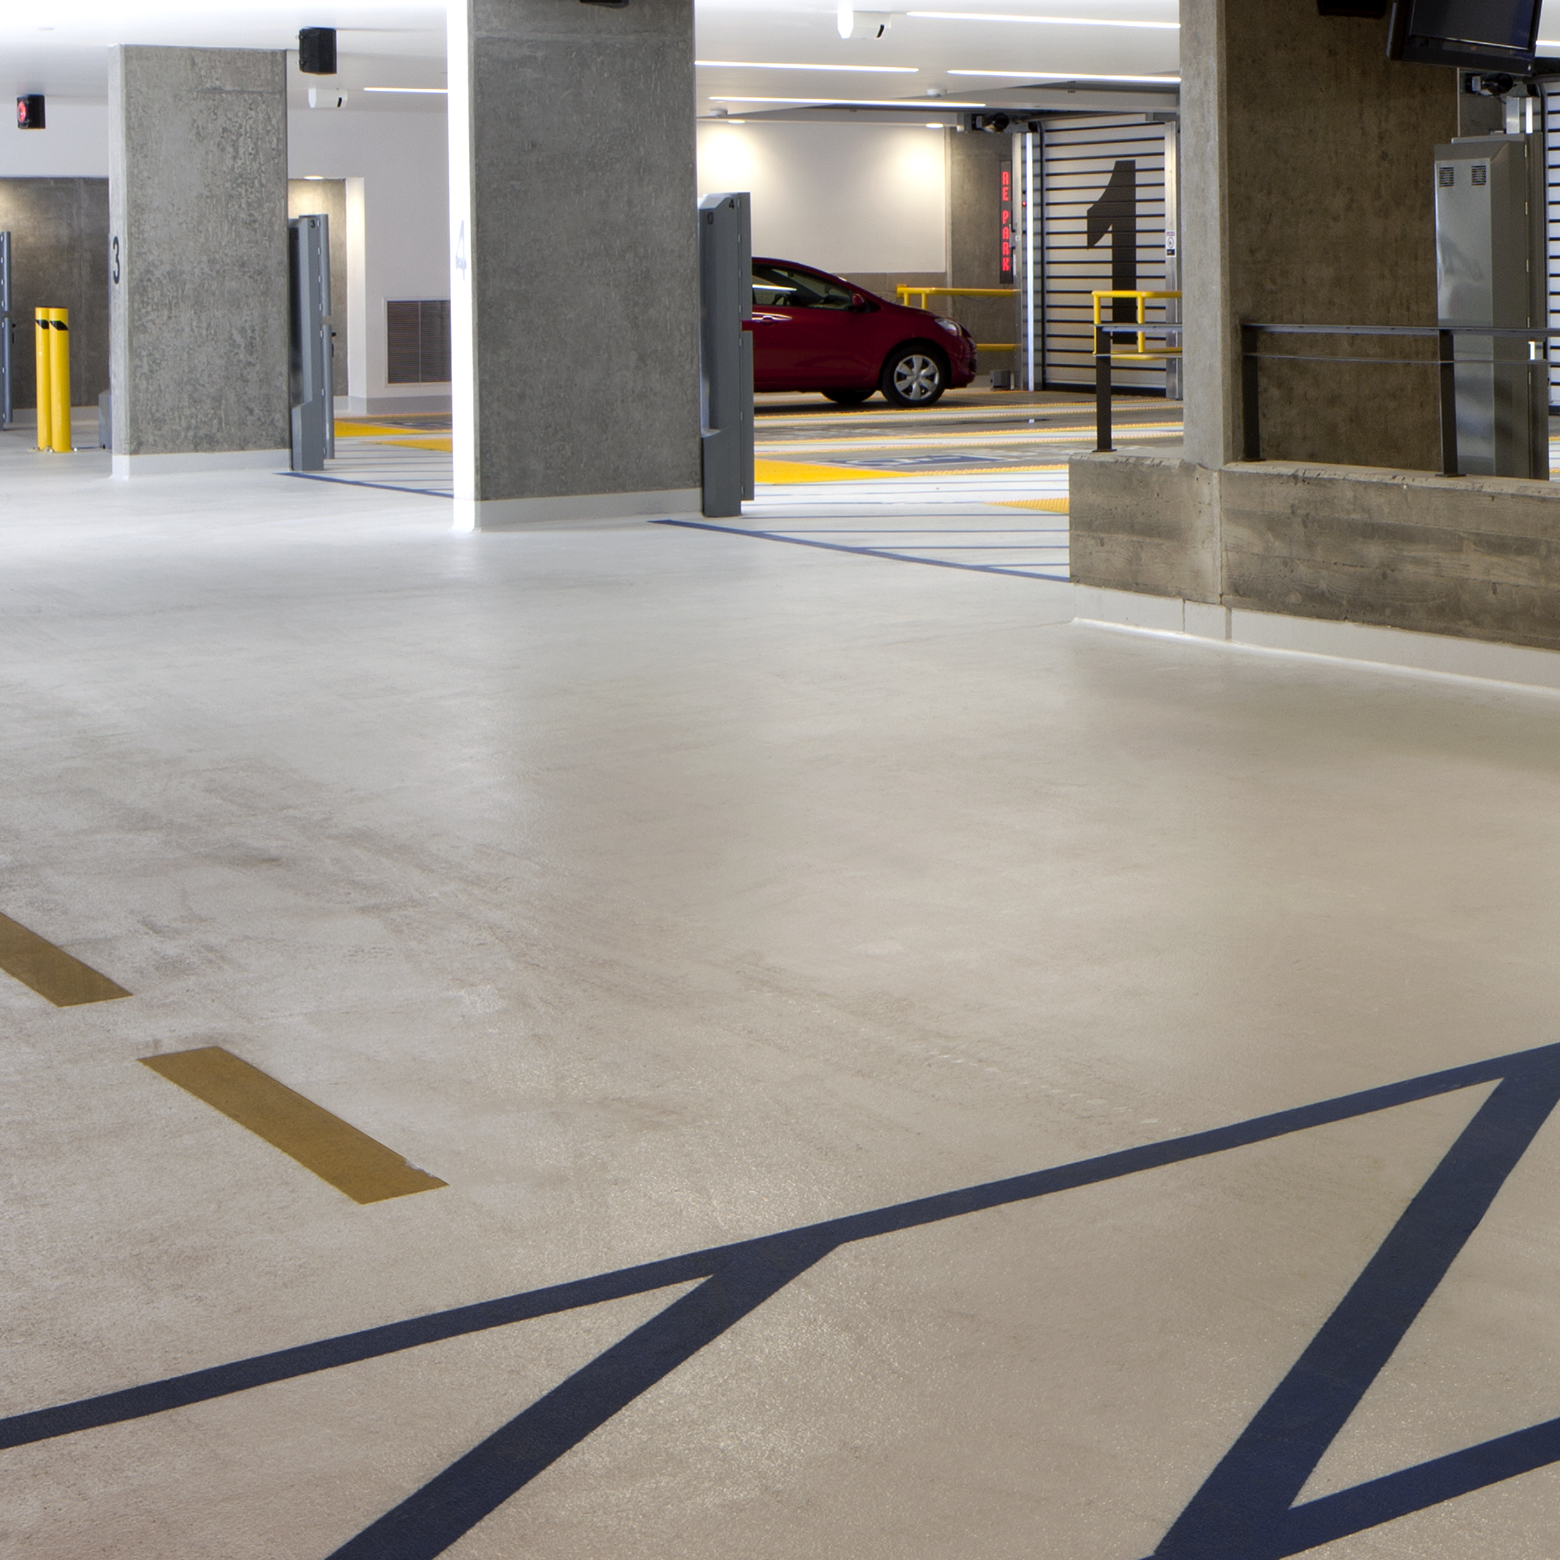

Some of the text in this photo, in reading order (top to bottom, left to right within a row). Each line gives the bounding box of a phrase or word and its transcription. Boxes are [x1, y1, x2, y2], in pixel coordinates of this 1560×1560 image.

[728, 198, 735, 210] 4
[112, 235, 120, 285] 3
[455, 219, 467, 281] 4
[1087, 159, 1137, 344] 1
